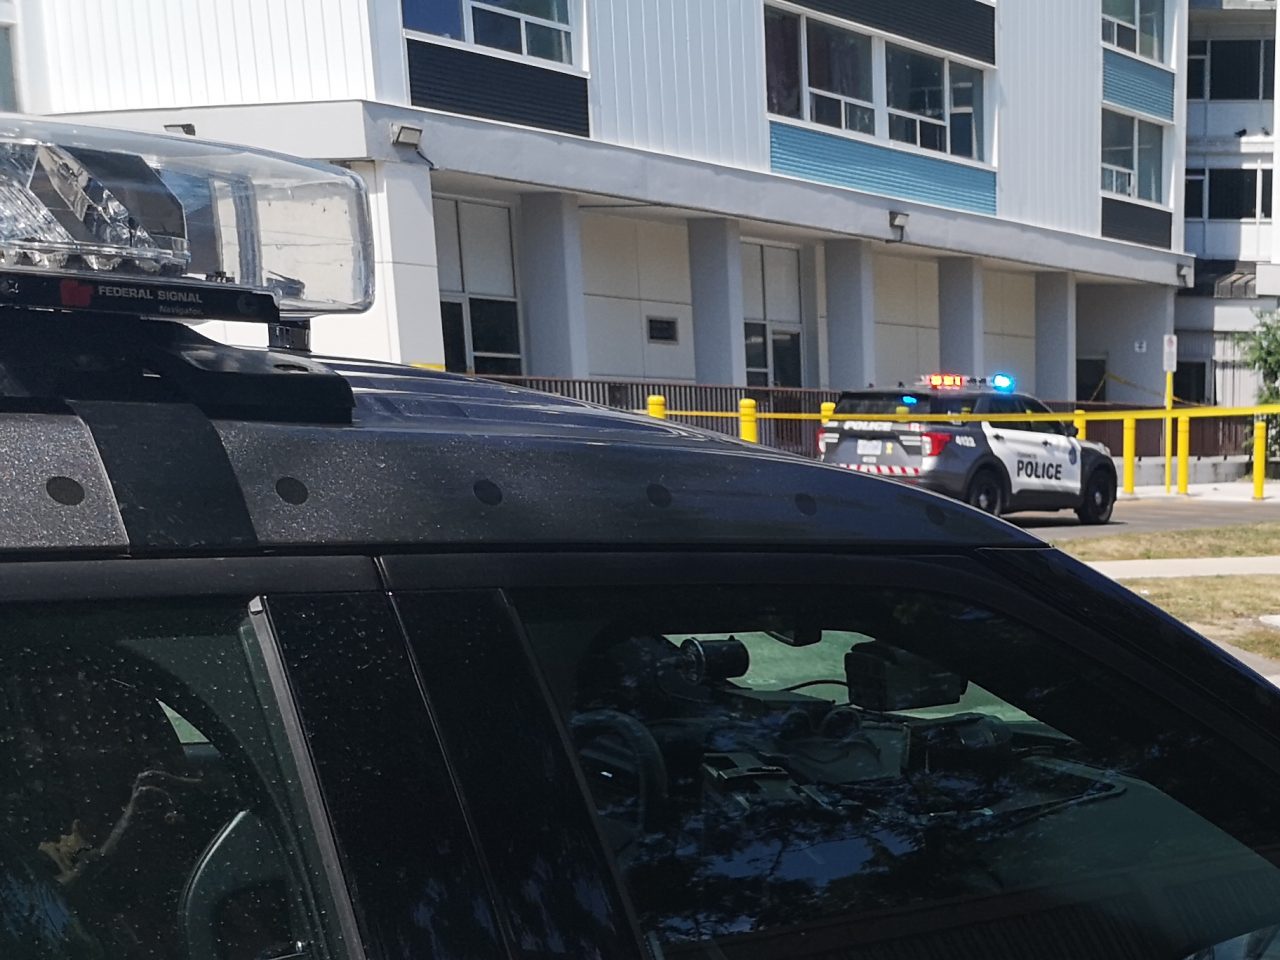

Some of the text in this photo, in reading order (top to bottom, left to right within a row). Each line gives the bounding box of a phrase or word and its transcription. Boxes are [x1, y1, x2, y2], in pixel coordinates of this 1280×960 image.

[98, 285, 203, 303] FEDERAL SIGNAL
[843, 420, 893, 432] POLICE
[1017, 460, 1063, 480] POLICE
